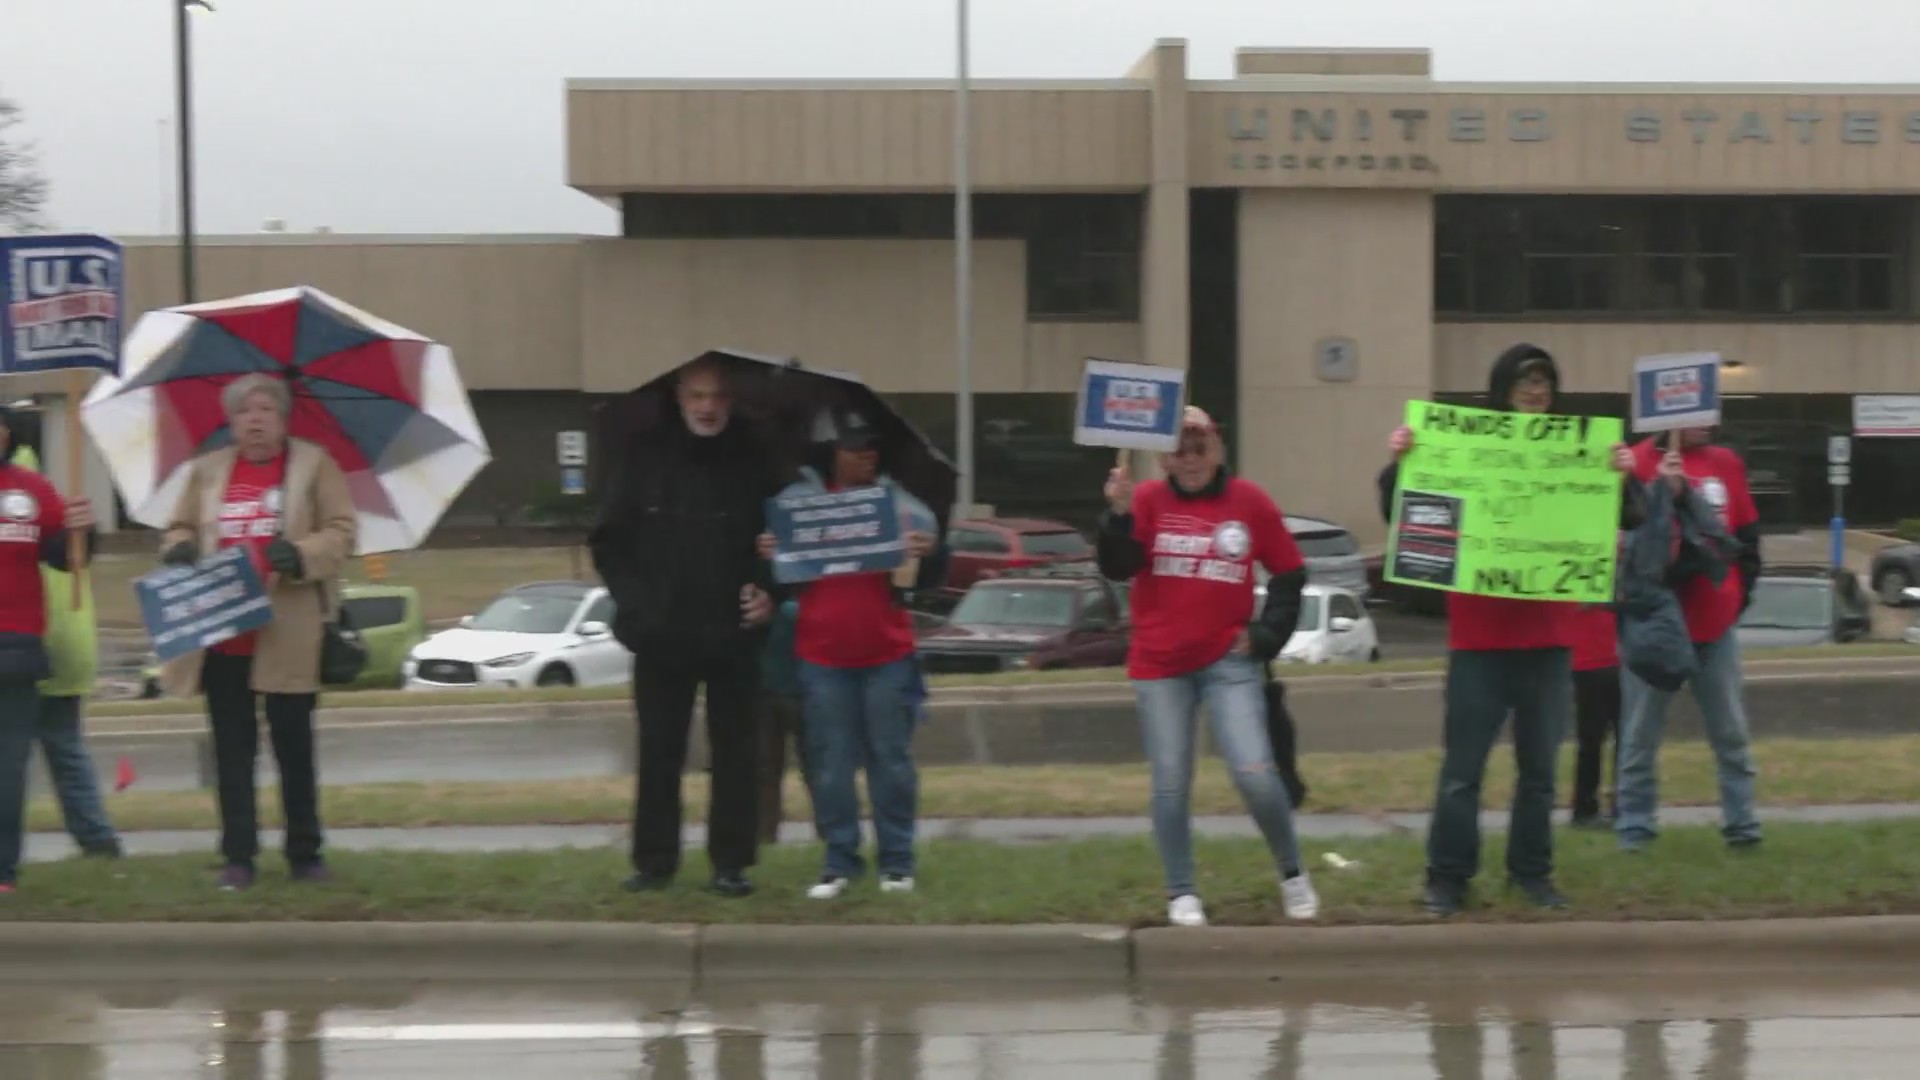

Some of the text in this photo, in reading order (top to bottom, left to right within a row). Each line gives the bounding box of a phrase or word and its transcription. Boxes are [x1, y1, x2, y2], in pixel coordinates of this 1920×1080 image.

[1227, 107, 1551, 143] UNITED
[1424, 405, 1515, 439] HANDS
[1474, 565, 1548, 595] NALC
